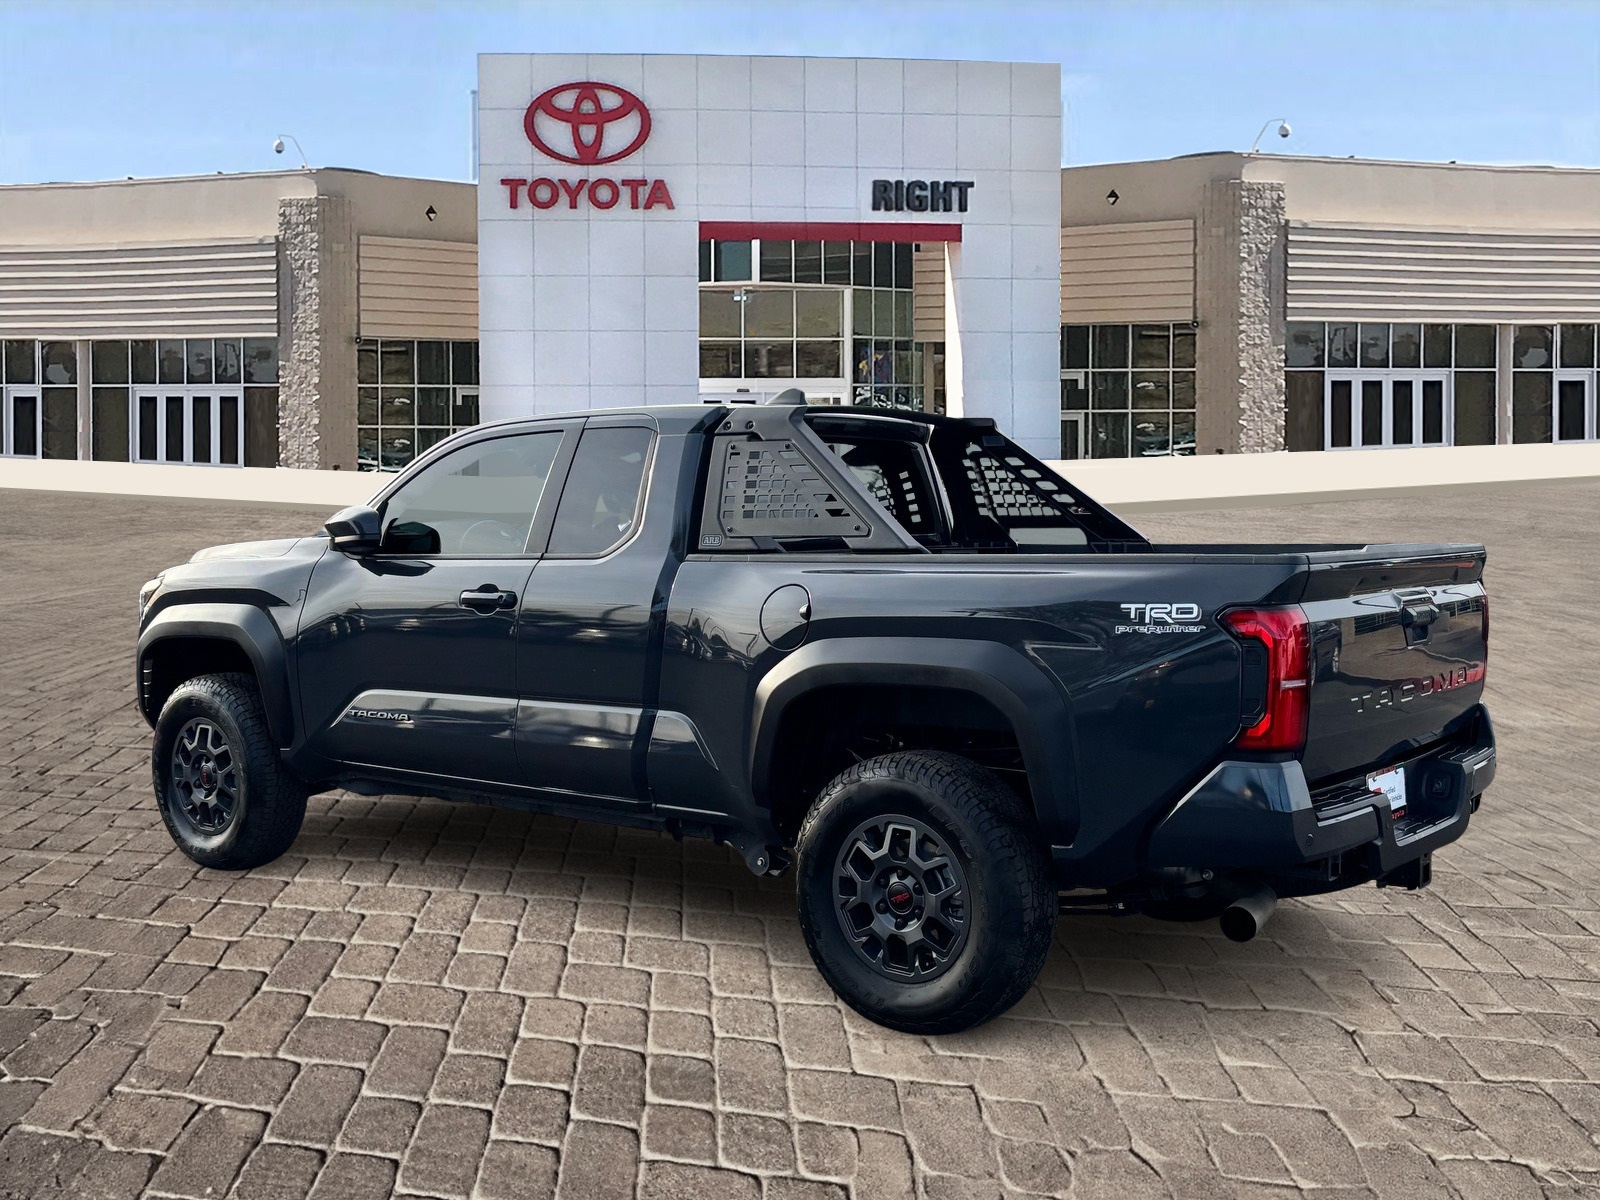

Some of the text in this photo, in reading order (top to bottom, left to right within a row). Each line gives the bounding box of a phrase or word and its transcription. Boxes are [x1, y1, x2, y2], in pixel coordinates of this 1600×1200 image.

[500, 178, 675, 210] TOYOTA
[872, 179, 975, 213] RIGHT
[703, 536, 720, 544] ARB
[1120, 603, 1202, 623] TRD
[1350, 666, 1467, 713] TACOMA
[348, 709, 409, 721] TACOMA
[890, 892, 910, 903] TRD
